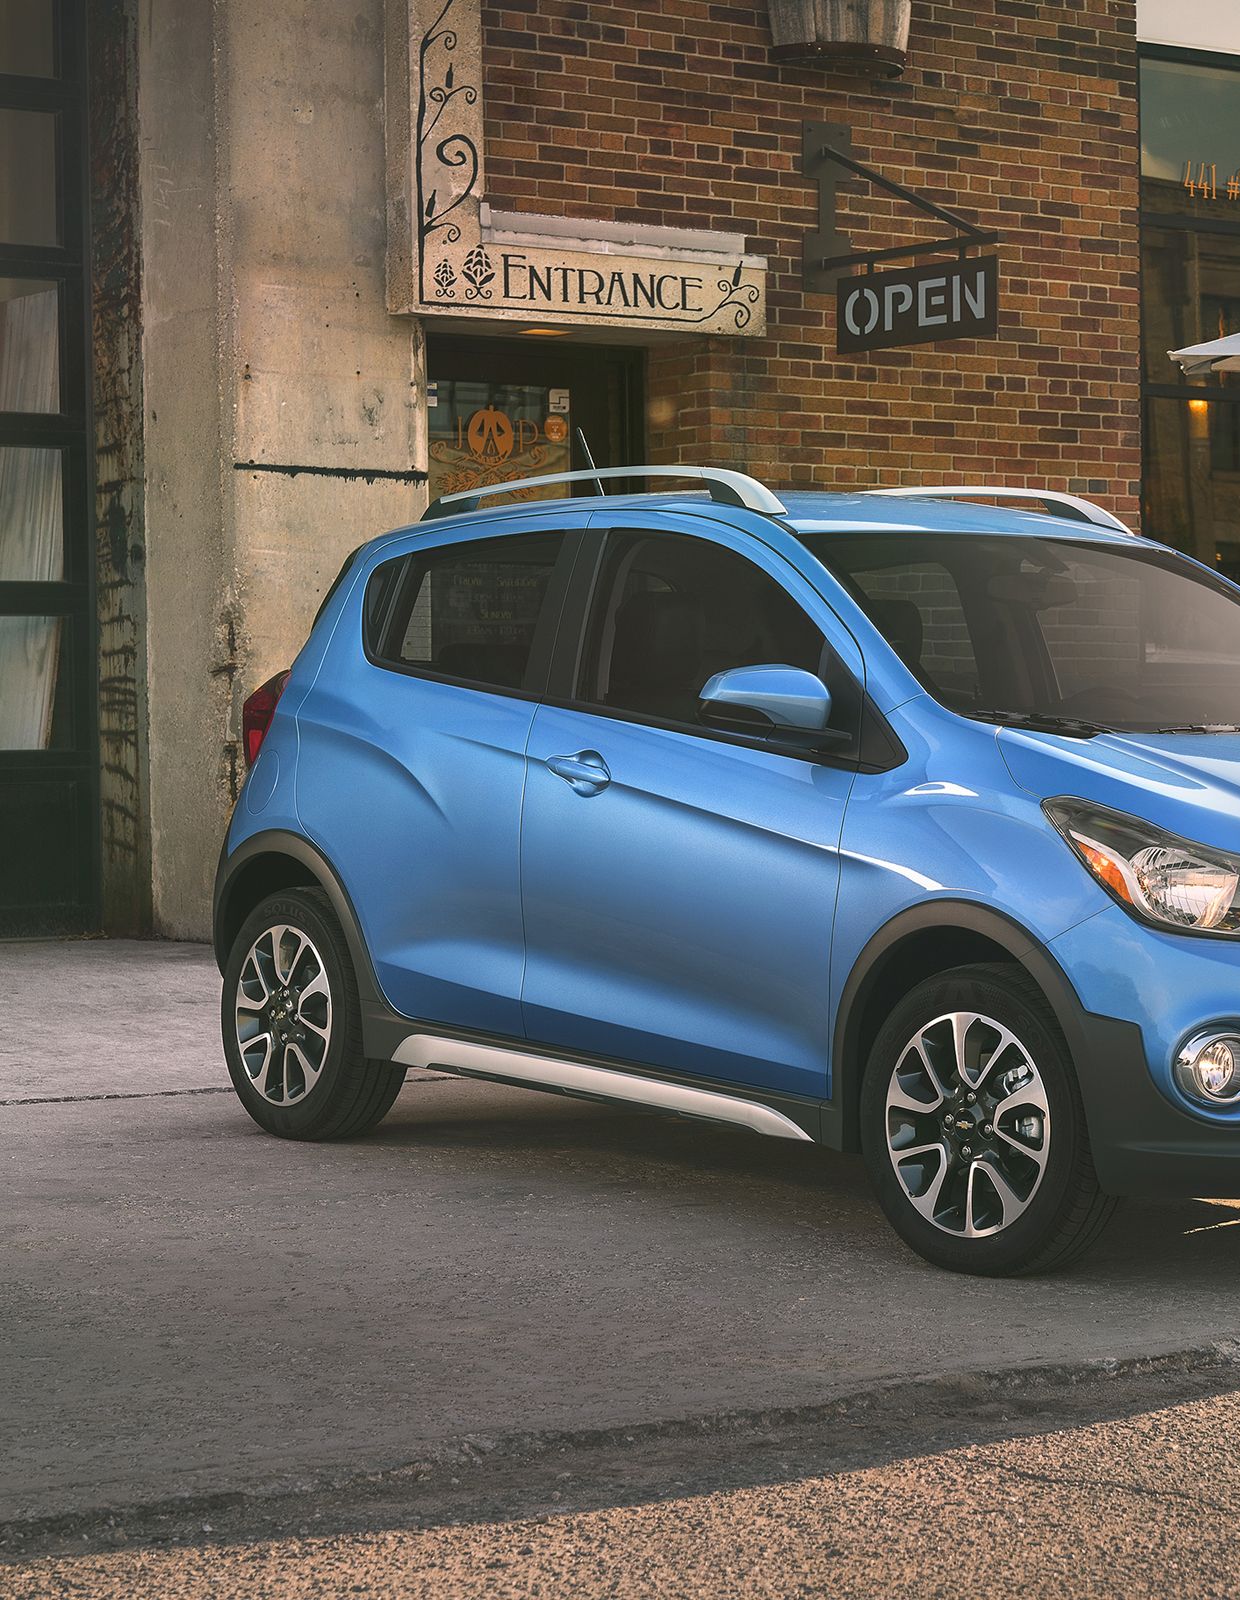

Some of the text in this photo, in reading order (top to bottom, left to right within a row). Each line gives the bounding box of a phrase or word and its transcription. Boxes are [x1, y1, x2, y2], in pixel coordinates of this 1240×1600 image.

[1184, 160, 1217, 200] 441
[501, 253, 703, 312] ENTRANCE
[845, 271, 986, 336] OPEN
[264, 903, 307, 920] SOLUS
